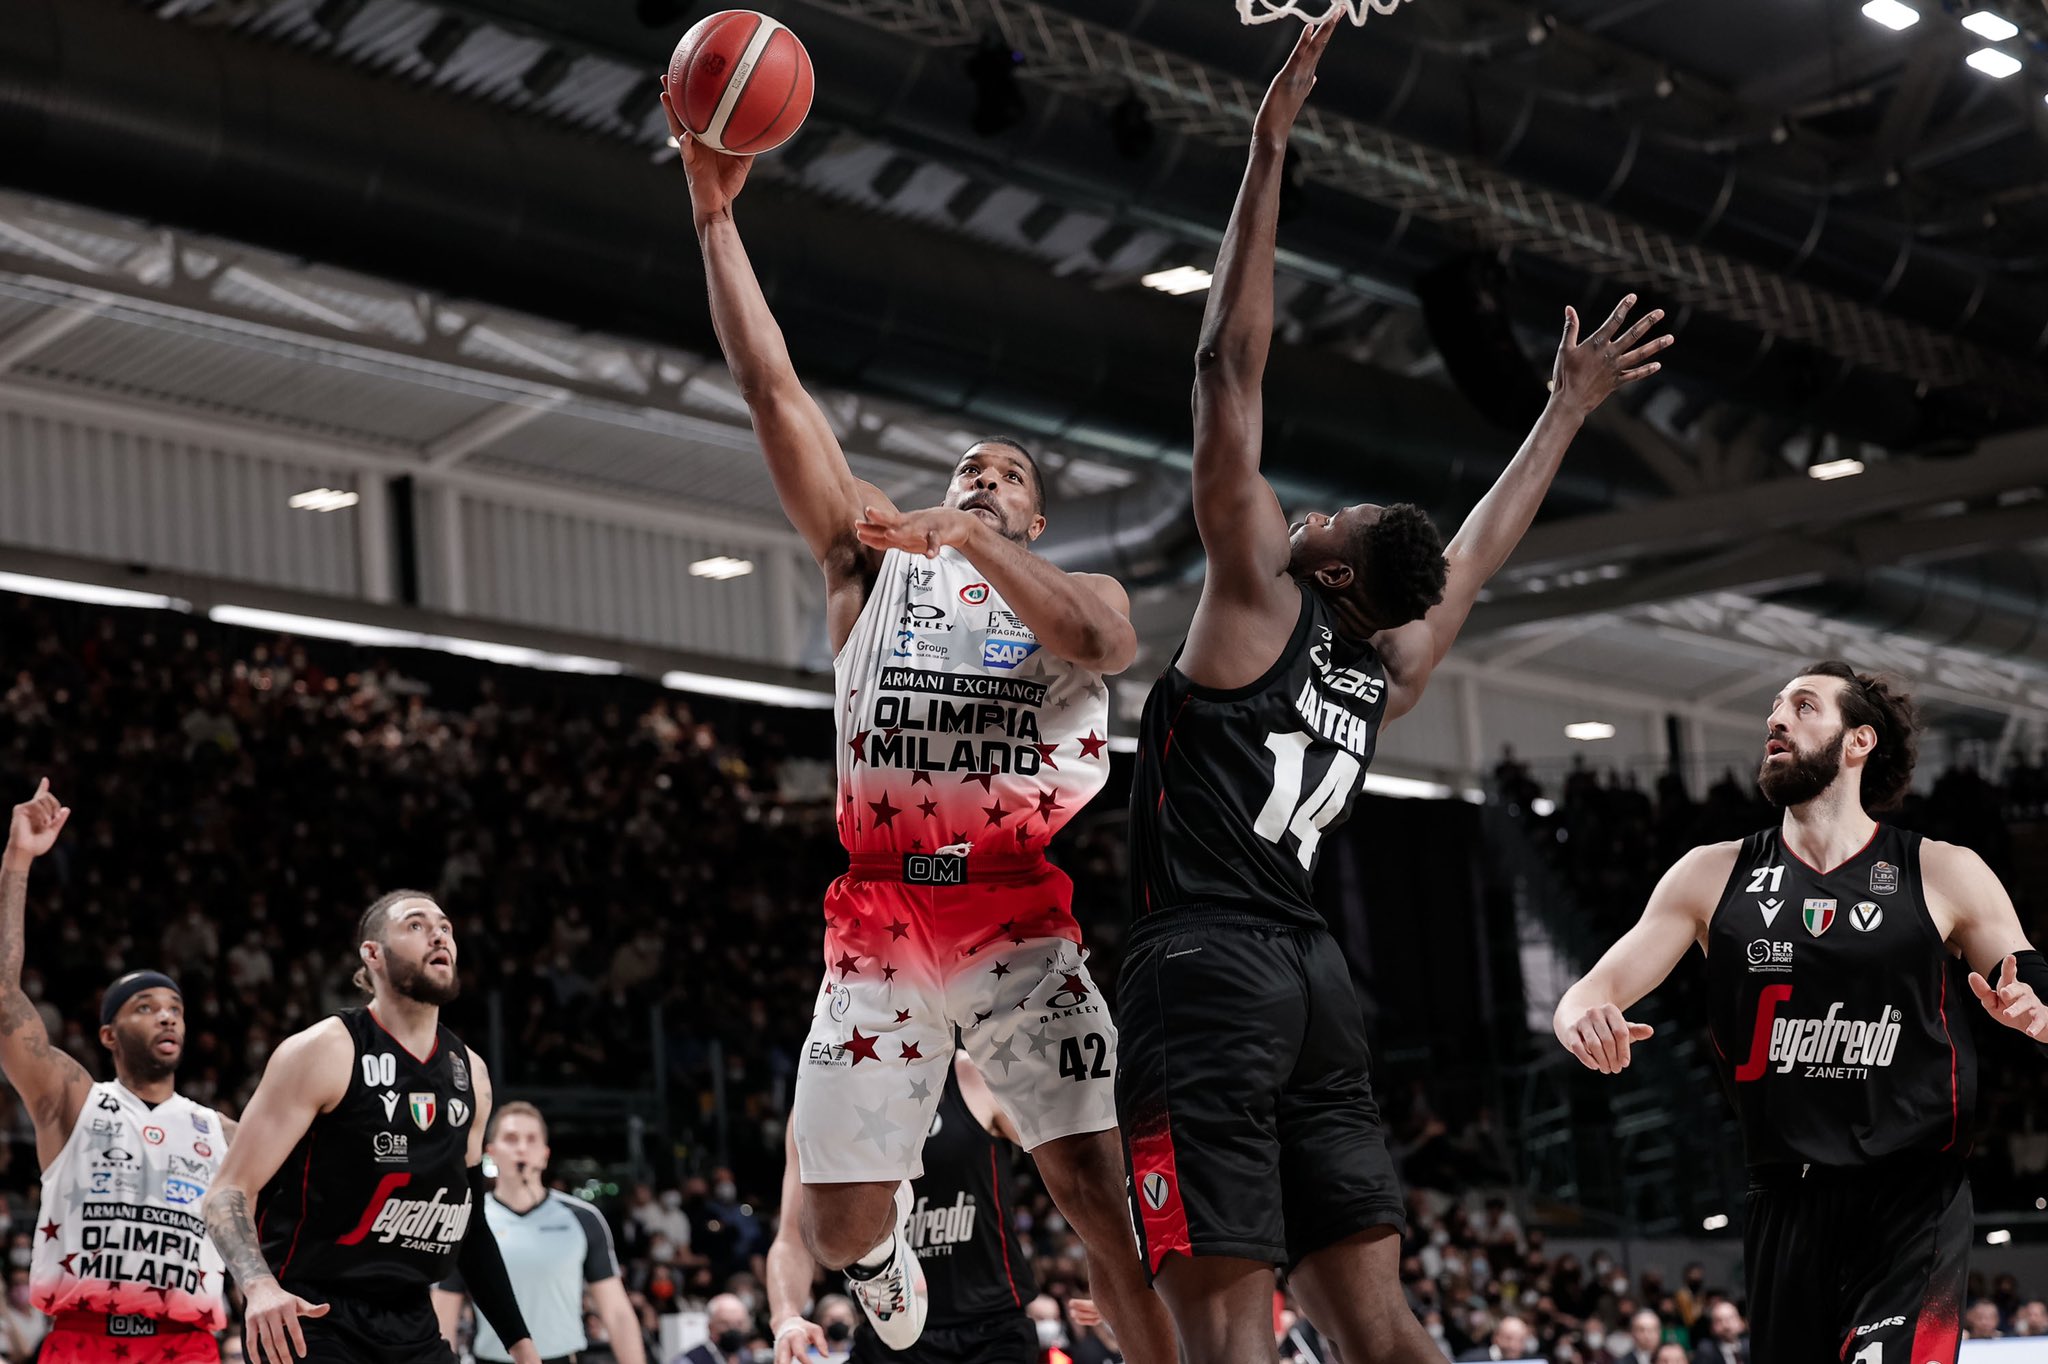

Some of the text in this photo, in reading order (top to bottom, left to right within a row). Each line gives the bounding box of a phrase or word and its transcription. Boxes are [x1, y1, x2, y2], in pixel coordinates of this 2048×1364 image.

[916, 640, 948, 656] Group
[984, 643, 1028, 664] SAP
[882, 669, 1047, 703] ARMANI EXCHANGE
[874, 696, 1040, 743] OLIMPIA
[1295, 677, 1367, 756] JAITEH
[870, 735, 1041, 776] MILANO
[1253, 730, 1361, 871] 14
[908, 856, 961, 883] OM
[1745, 865, 1785, 893] 21
[1040, 1005, 1100, 1024] OAKLEY
[1735, 984, 1901, 1081] Segafredo
[361, 1053, 397, 1088] 00
[1058, 1032, 1111, 1082] 42
[1804, 1066, 1868, 1080] ZANETTI
[166, 1181, 199, 1200] SAP
[84, 1206, 206, 1238] ARMANI EXCHANGE
[904, 1191, 977, 1247] afredo
[82, 1226, 201, 1262] OLIMPIA
[80, 1254, 198, 1295] MILANO
[109, 1315, 154, 1335] OM
[1856, 1316, 1906, 1336] CARS
